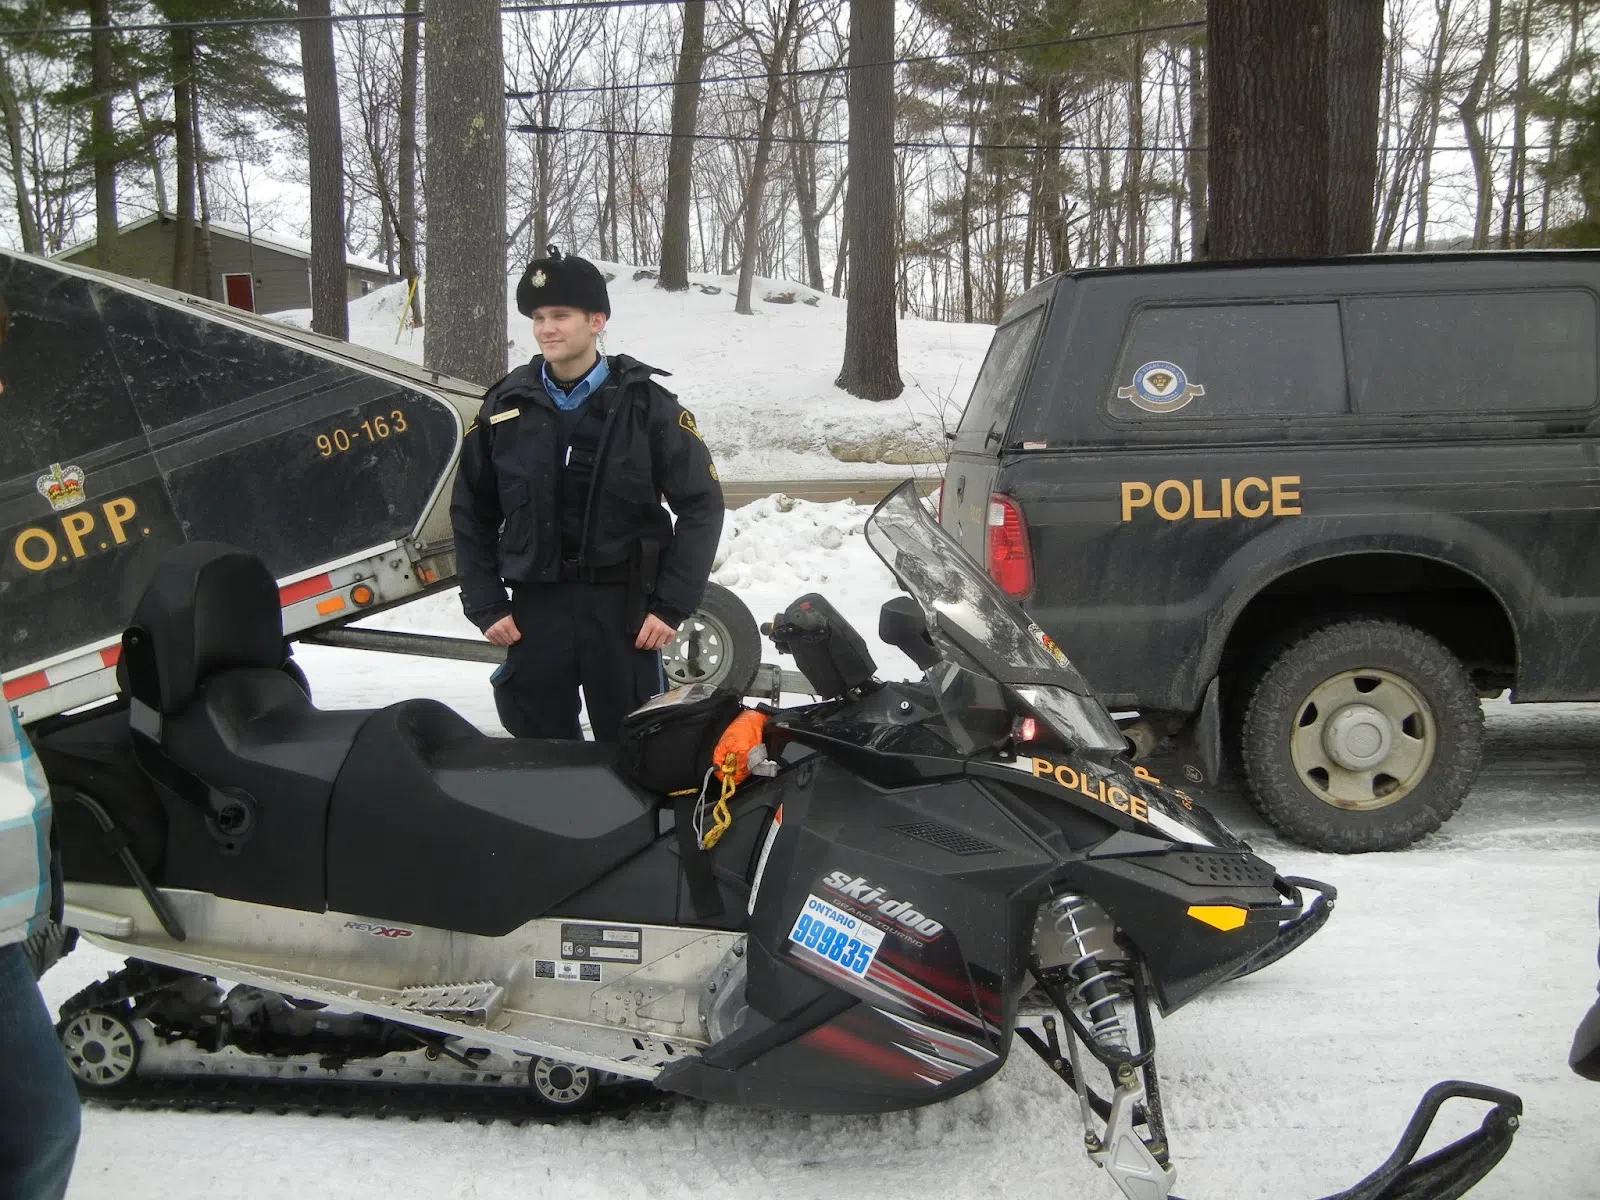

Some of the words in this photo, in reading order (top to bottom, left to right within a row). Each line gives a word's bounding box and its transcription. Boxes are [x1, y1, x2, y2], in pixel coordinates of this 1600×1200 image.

[317, 410, 407, 457] 90-163
[1121, 475, 1302, 522] POLICE
[14, 496, 150, 571] O.P.P.
[1032, 757, 1148, 824] POLICE
[808, 899, 856, 930] ONTARIO
[832, 898, 873, 922] GRAND
[876, 920, 924, 948] TOURING
[792, 913, 874, 974] 999835
